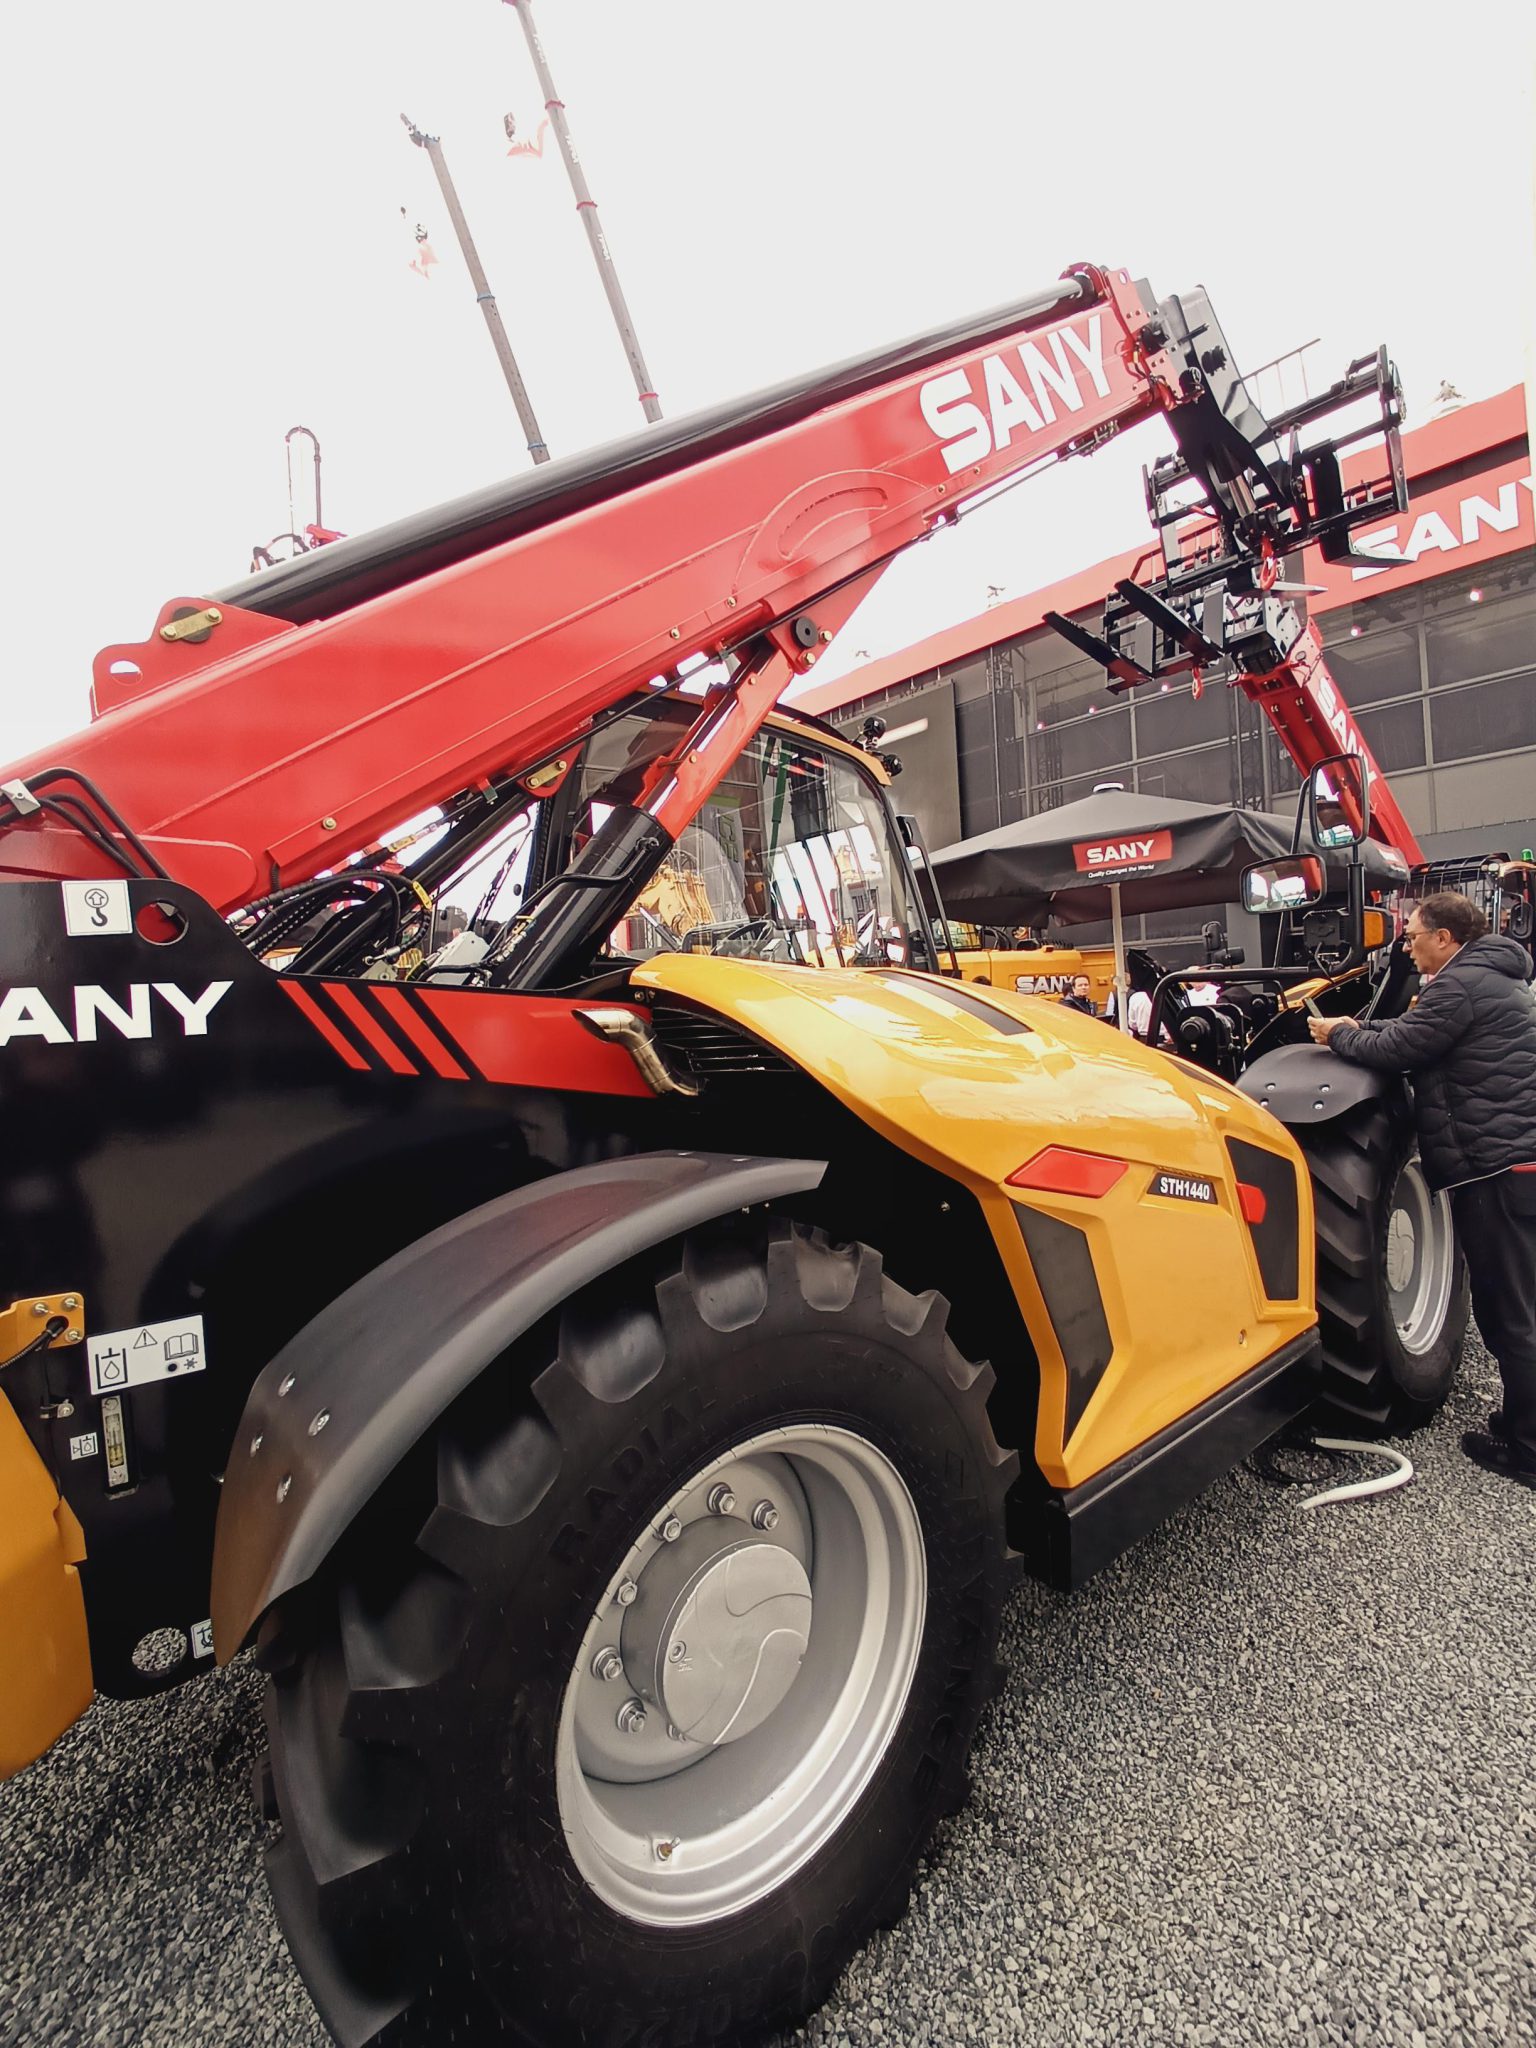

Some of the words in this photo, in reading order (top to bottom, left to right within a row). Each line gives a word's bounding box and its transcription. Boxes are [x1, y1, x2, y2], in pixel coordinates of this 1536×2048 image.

[920, 314, 1112, 475] SANY
[1086, 839, 1155, 864] SANY
[1160, 1176, 1210, 1201] STH1440
[548, 1386, 718, 1566] RADIAL
